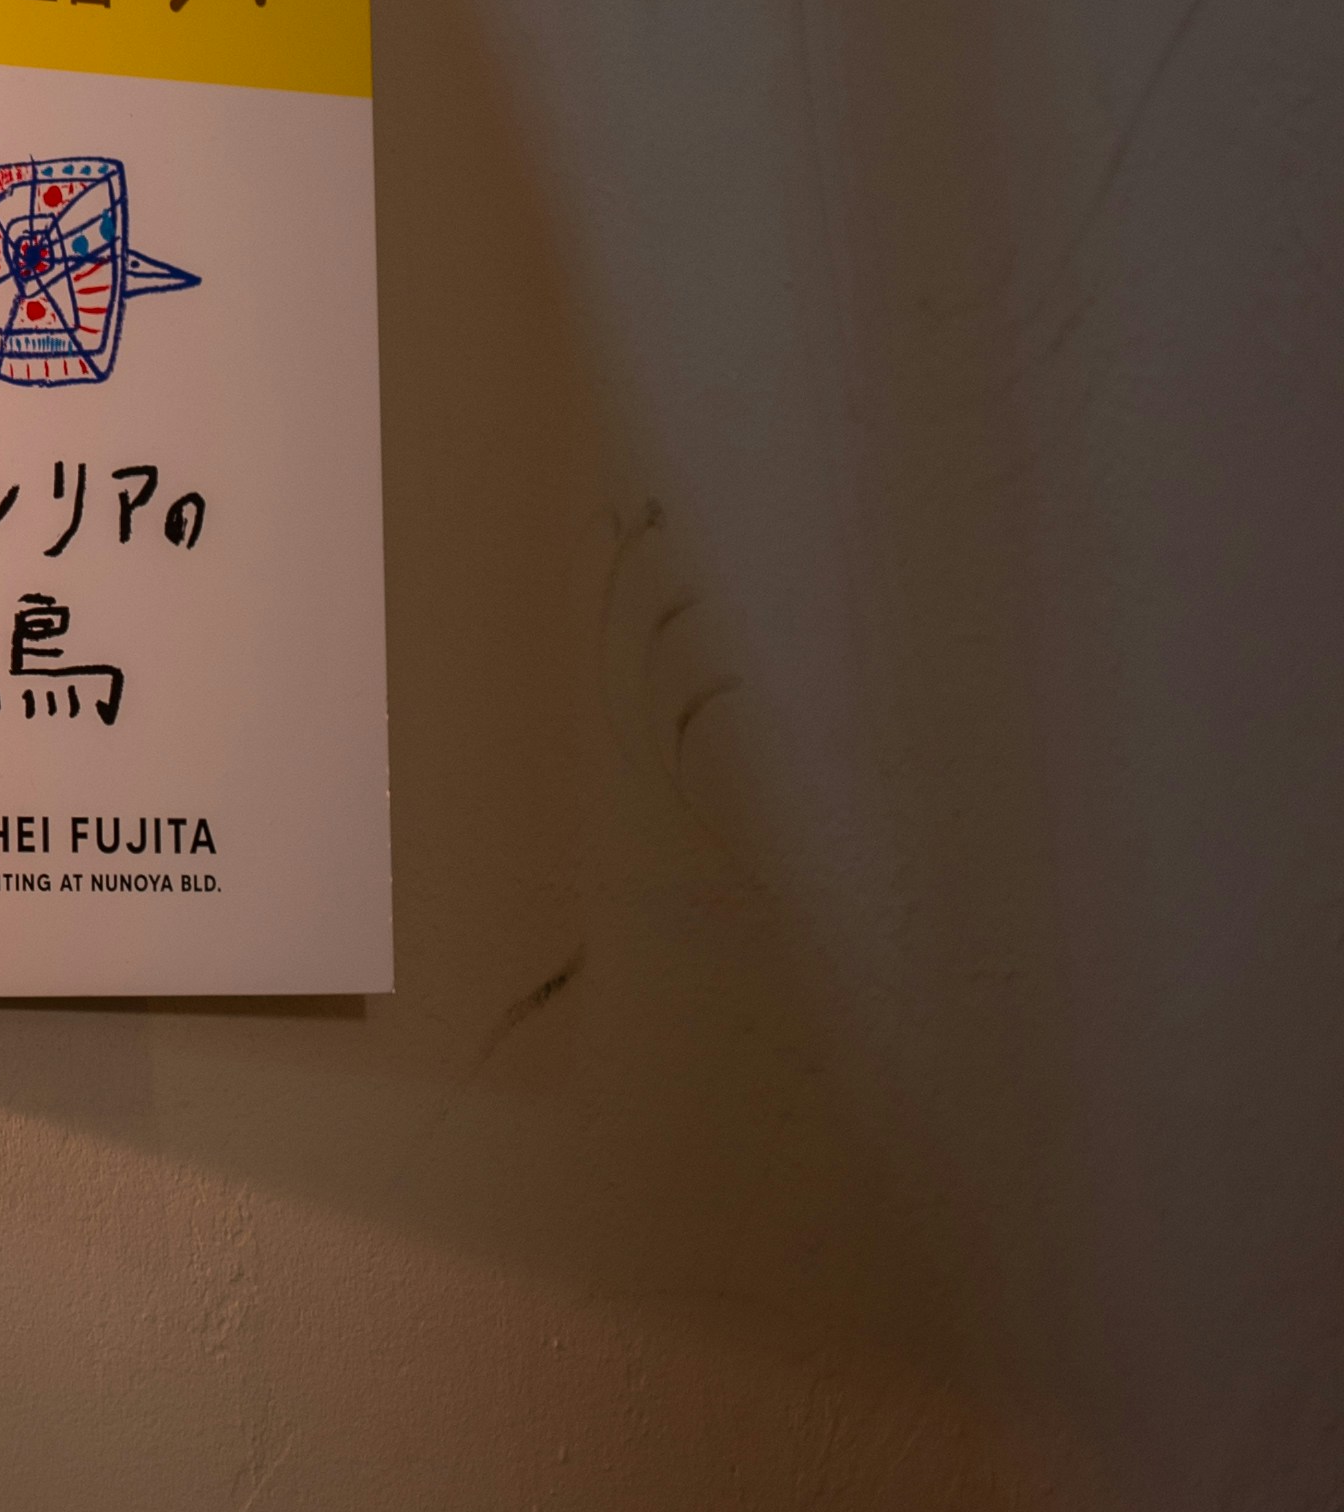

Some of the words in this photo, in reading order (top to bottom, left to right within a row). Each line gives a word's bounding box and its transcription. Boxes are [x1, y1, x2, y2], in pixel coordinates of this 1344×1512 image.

[71, 816, 217, 855] FUJITA
[59, 873, 83, 892] AT
[91, 874, 174, 892] NUNOYA
[181, 874, 222, 893] BLD.
